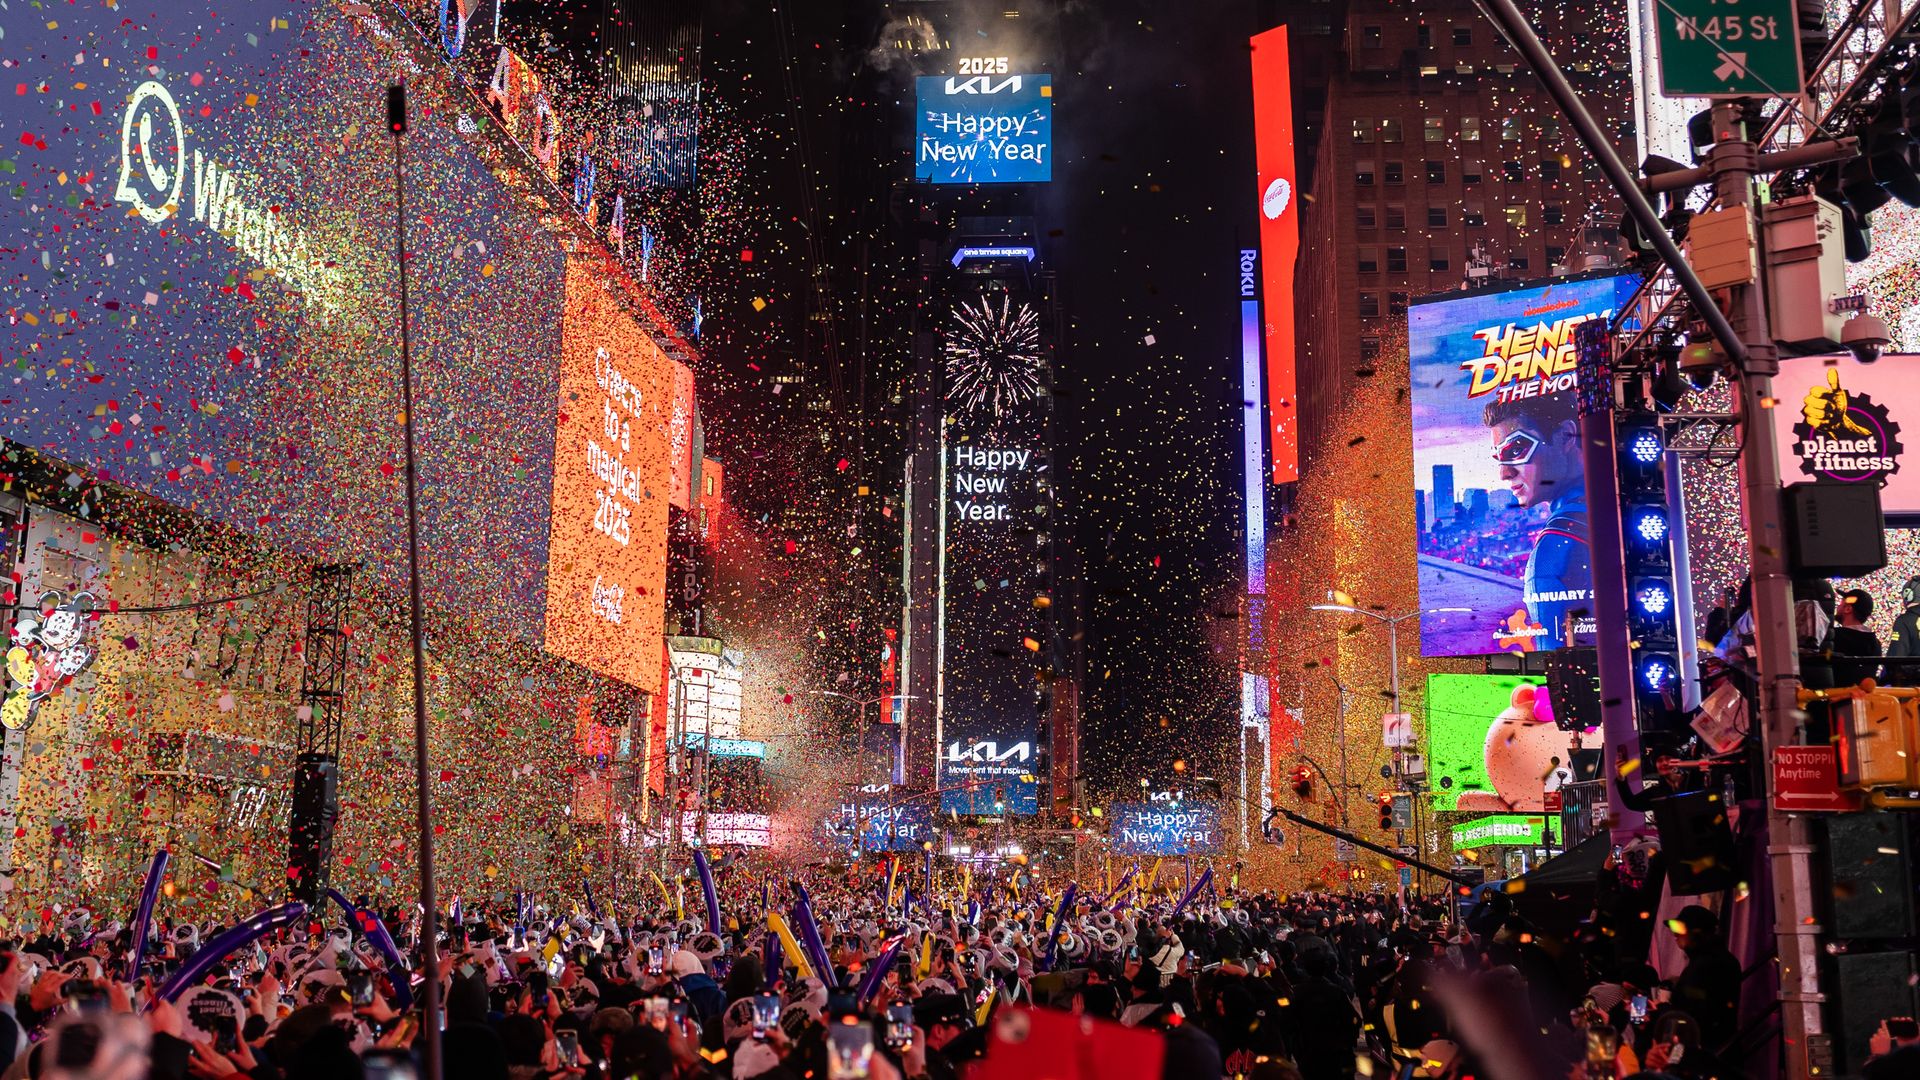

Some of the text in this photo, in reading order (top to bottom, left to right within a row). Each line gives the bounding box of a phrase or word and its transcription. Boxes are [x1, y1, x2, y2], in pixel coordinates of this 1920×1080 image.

[1675, 16, 1778, 40] W 45 St
[958, 57, 1009, 75] 2025
[944, 75, 1022, 95] KIA
[943, 112, 1028, 138] Happy
[921, 140, 1047, 161] New Year
[595, 346, 643, 419] Cheers
[1498, 380, 1541, 405] THE
[604, 398, 631, 453] to a
[1802, 435, 1878, 458] planet
[955, 446, 1030, 471] Happy
[1814, 453, 1895, 470] fitness
[586, 439, 641, 506] magical
[956, 474, 1006, 493] New
[594, 489, 632, 547] 2025
[1523, 590, 1587, 603] JANUARY
[949, 741, 1030, 762] KIA
[1778, 753, 1793, 764] NO
[1779, 767, 1822, 781] Anytime
[1138, 811, 1199, 828] Happy
[1123, 828, 1211, 843] New Year
